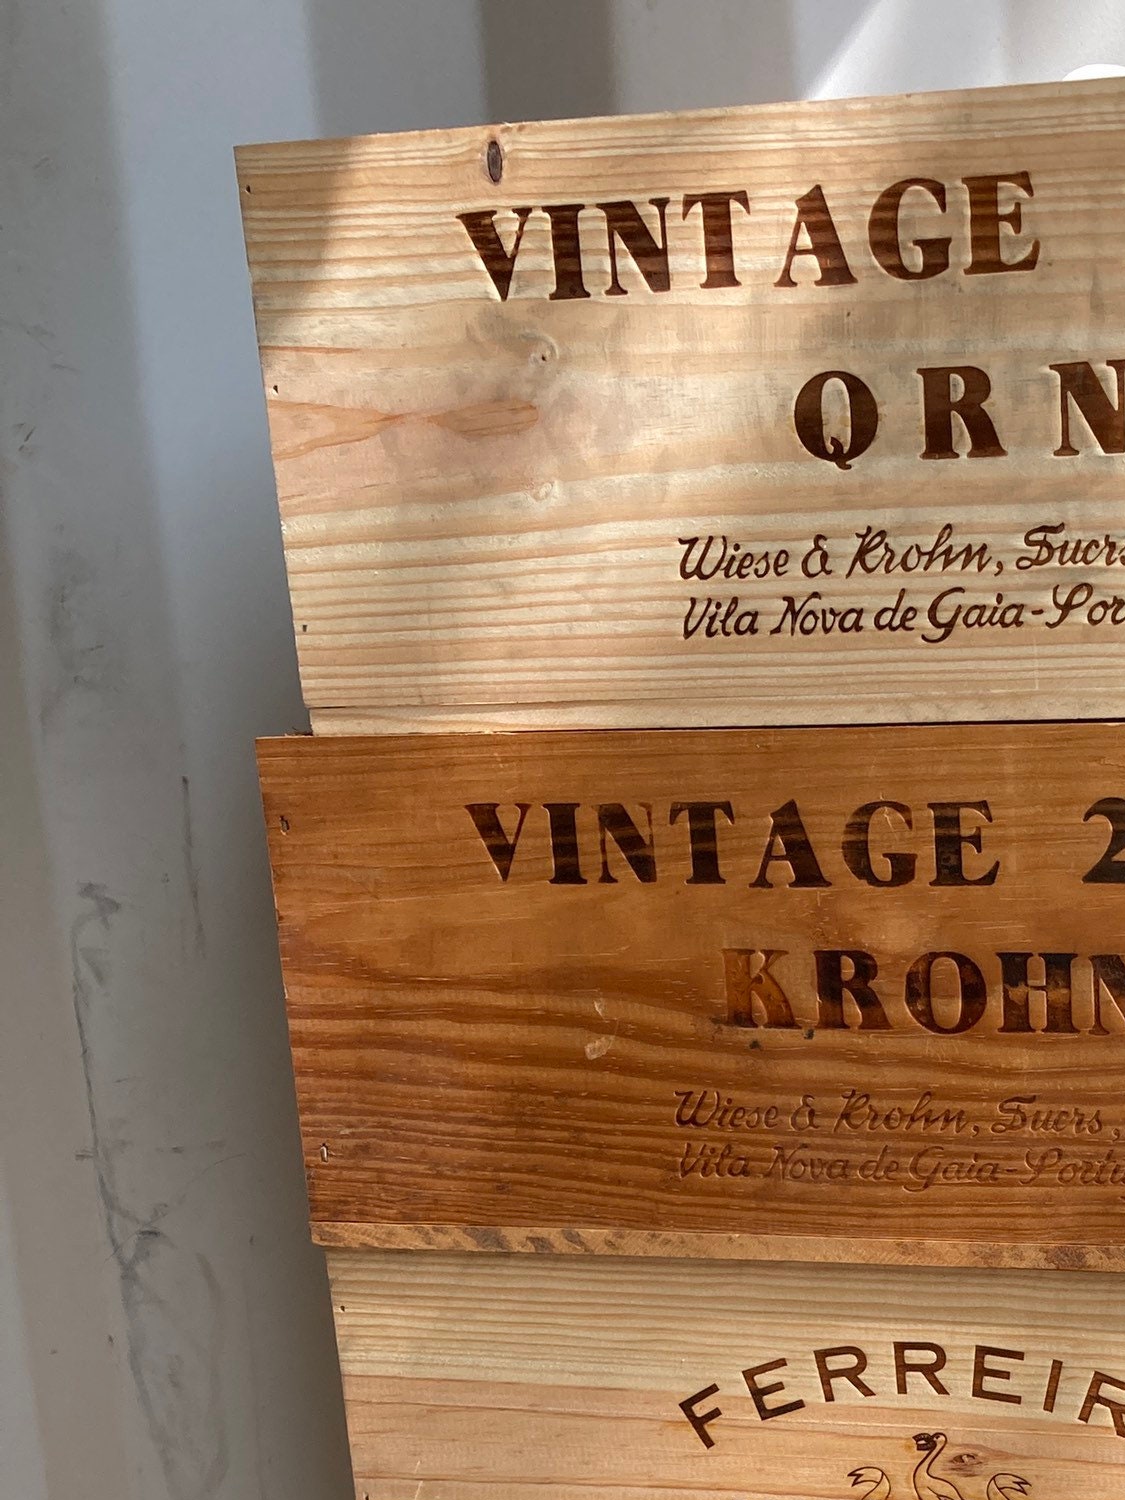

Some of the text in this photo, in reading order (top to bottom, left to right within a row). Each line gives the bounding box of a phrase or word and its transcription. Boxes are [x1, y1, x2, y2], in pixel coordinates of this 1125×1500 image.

[456, 170, 1041, 302] VINTAGE
[677, 534, 790, 582] Wiese
[800, 534, 833, 579] &
[845, 523, 1005, 579] Krohn,
[682, 596, 759, 640] Vila
[769, 591, 864, 637] Nova
[873, 588, 918, 634] de
[463, 799, 1000, 891] VINTAGE
[673, 1088, 779, 1132] Wiese
[789, 1093, 821, 1132] &
[830, 1087, 981, 1138] Krohn,
[676, 1141, 751, 1180] Vila
[761, 1142, 851, 1182] Nova
[856, 1142, 901, 1181] de
